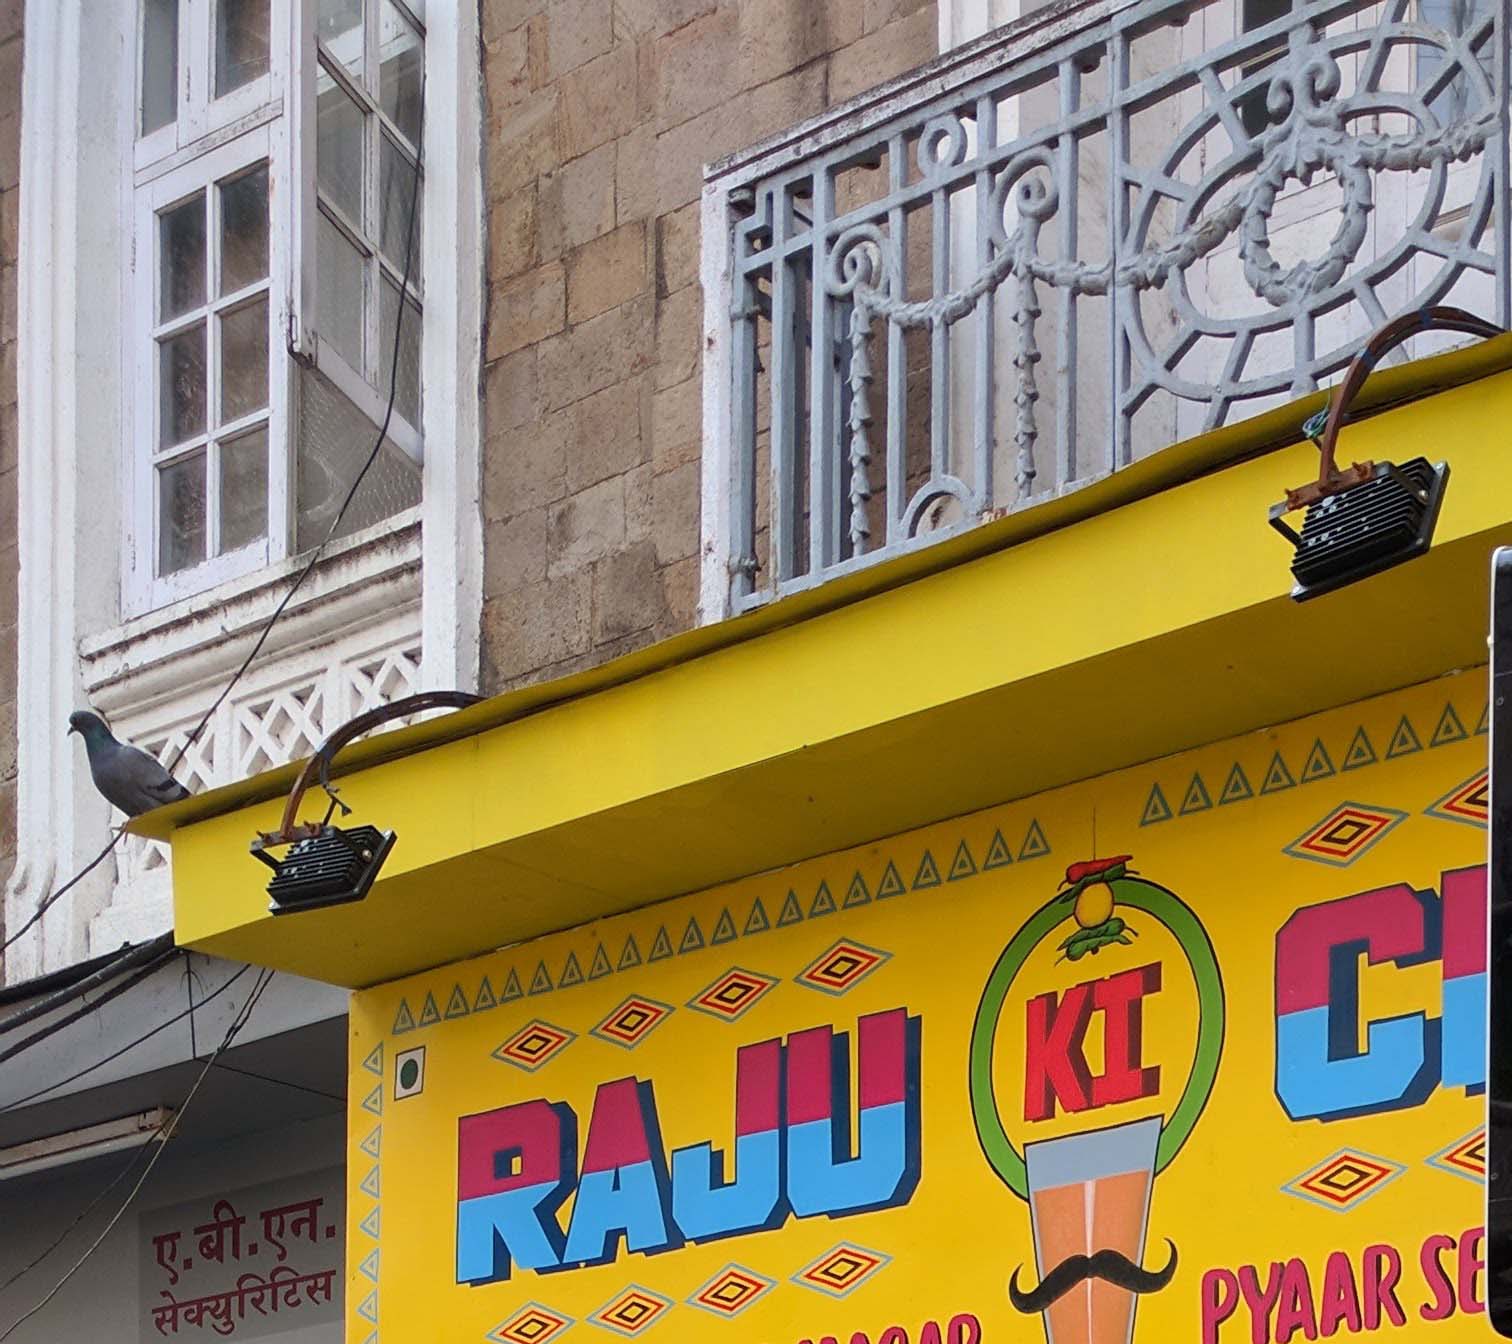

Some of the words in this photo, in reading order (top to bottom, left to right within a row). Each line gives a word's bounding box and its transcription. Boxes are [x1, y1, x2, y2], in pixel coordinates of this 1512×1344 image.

[456, 1007, 922, 1287] RAJU
[1024, 961, 1162, 1122] KI
[1420, 1226, 1486, 1321] SE
